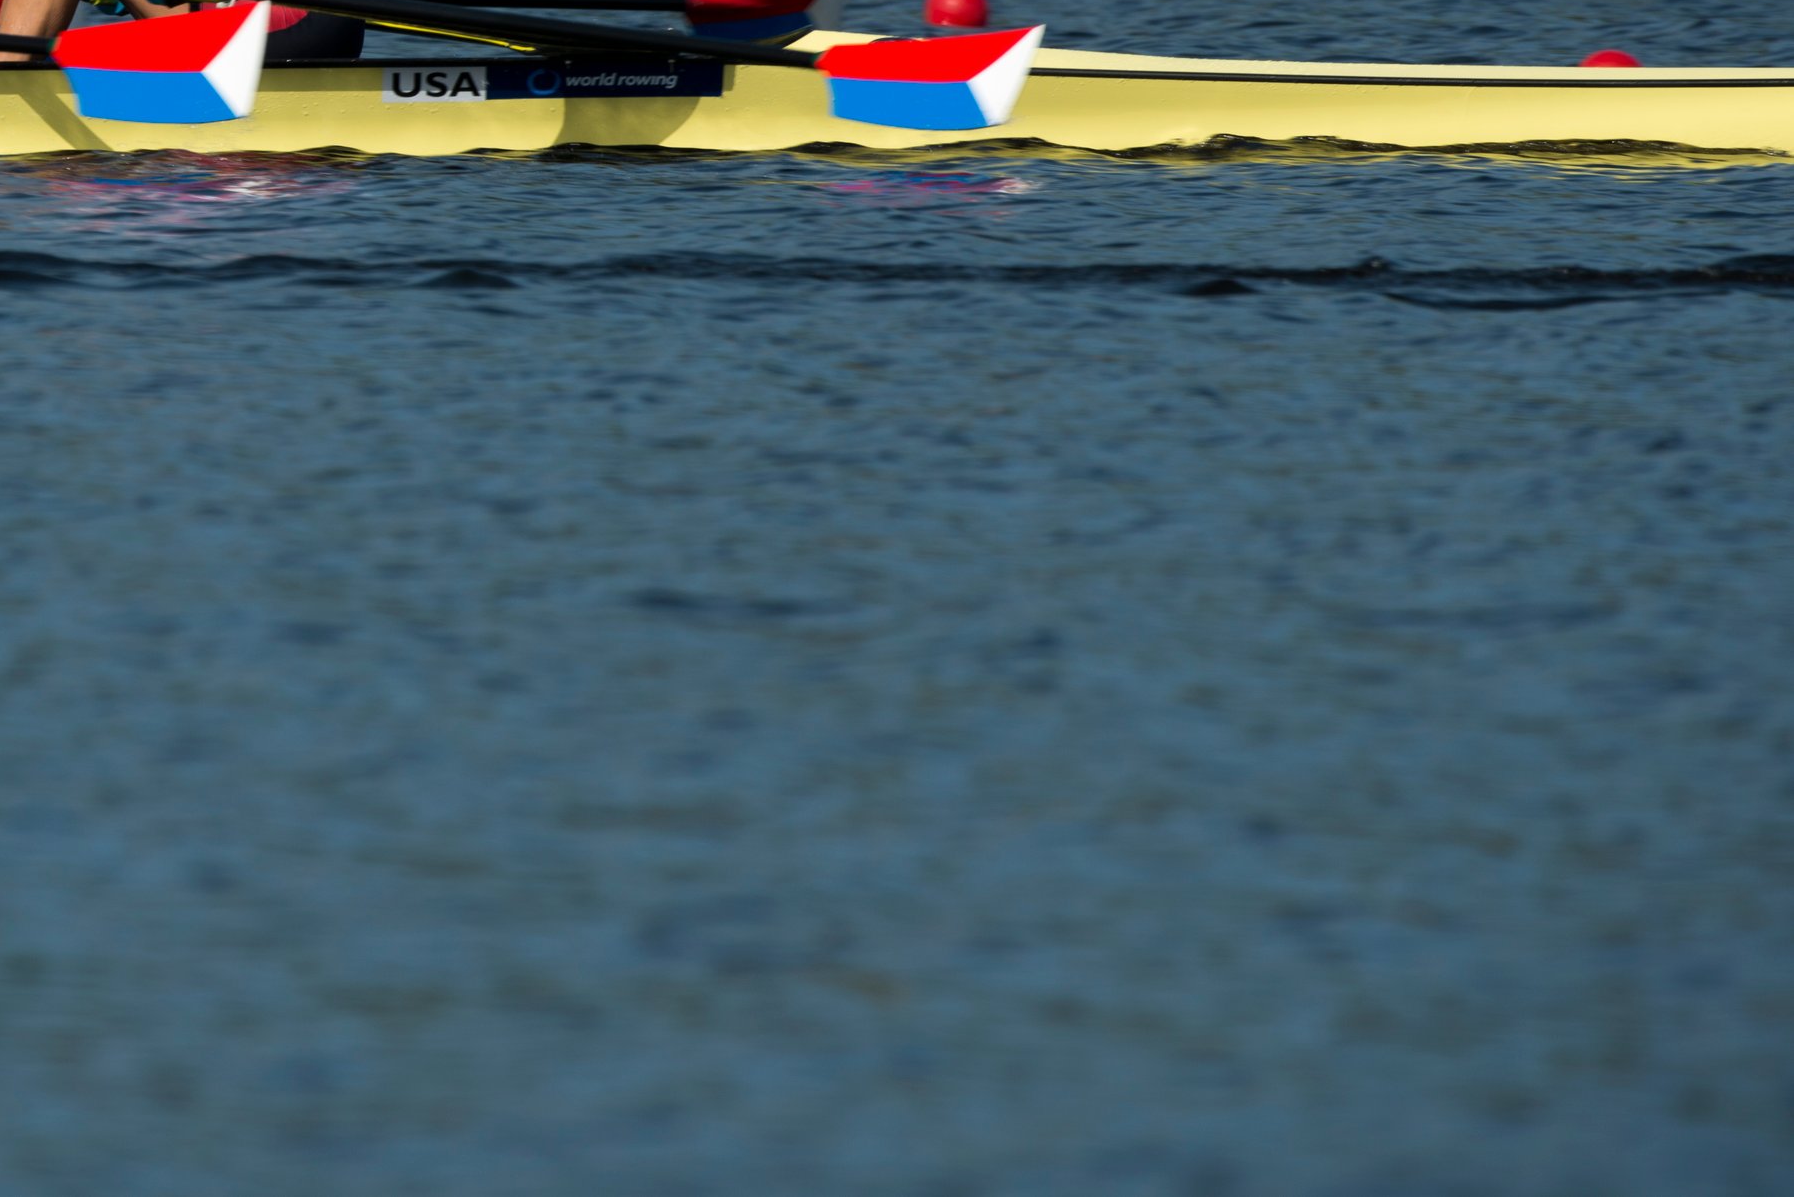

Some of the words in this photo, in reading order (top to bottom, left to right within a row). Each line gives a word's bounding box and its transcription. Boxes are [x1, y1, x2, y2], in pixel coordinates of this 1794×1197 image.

[391, 72, 481, 98] USA
[565, 72, 617, 88] world
[618, 74, 679, 90] rowing
